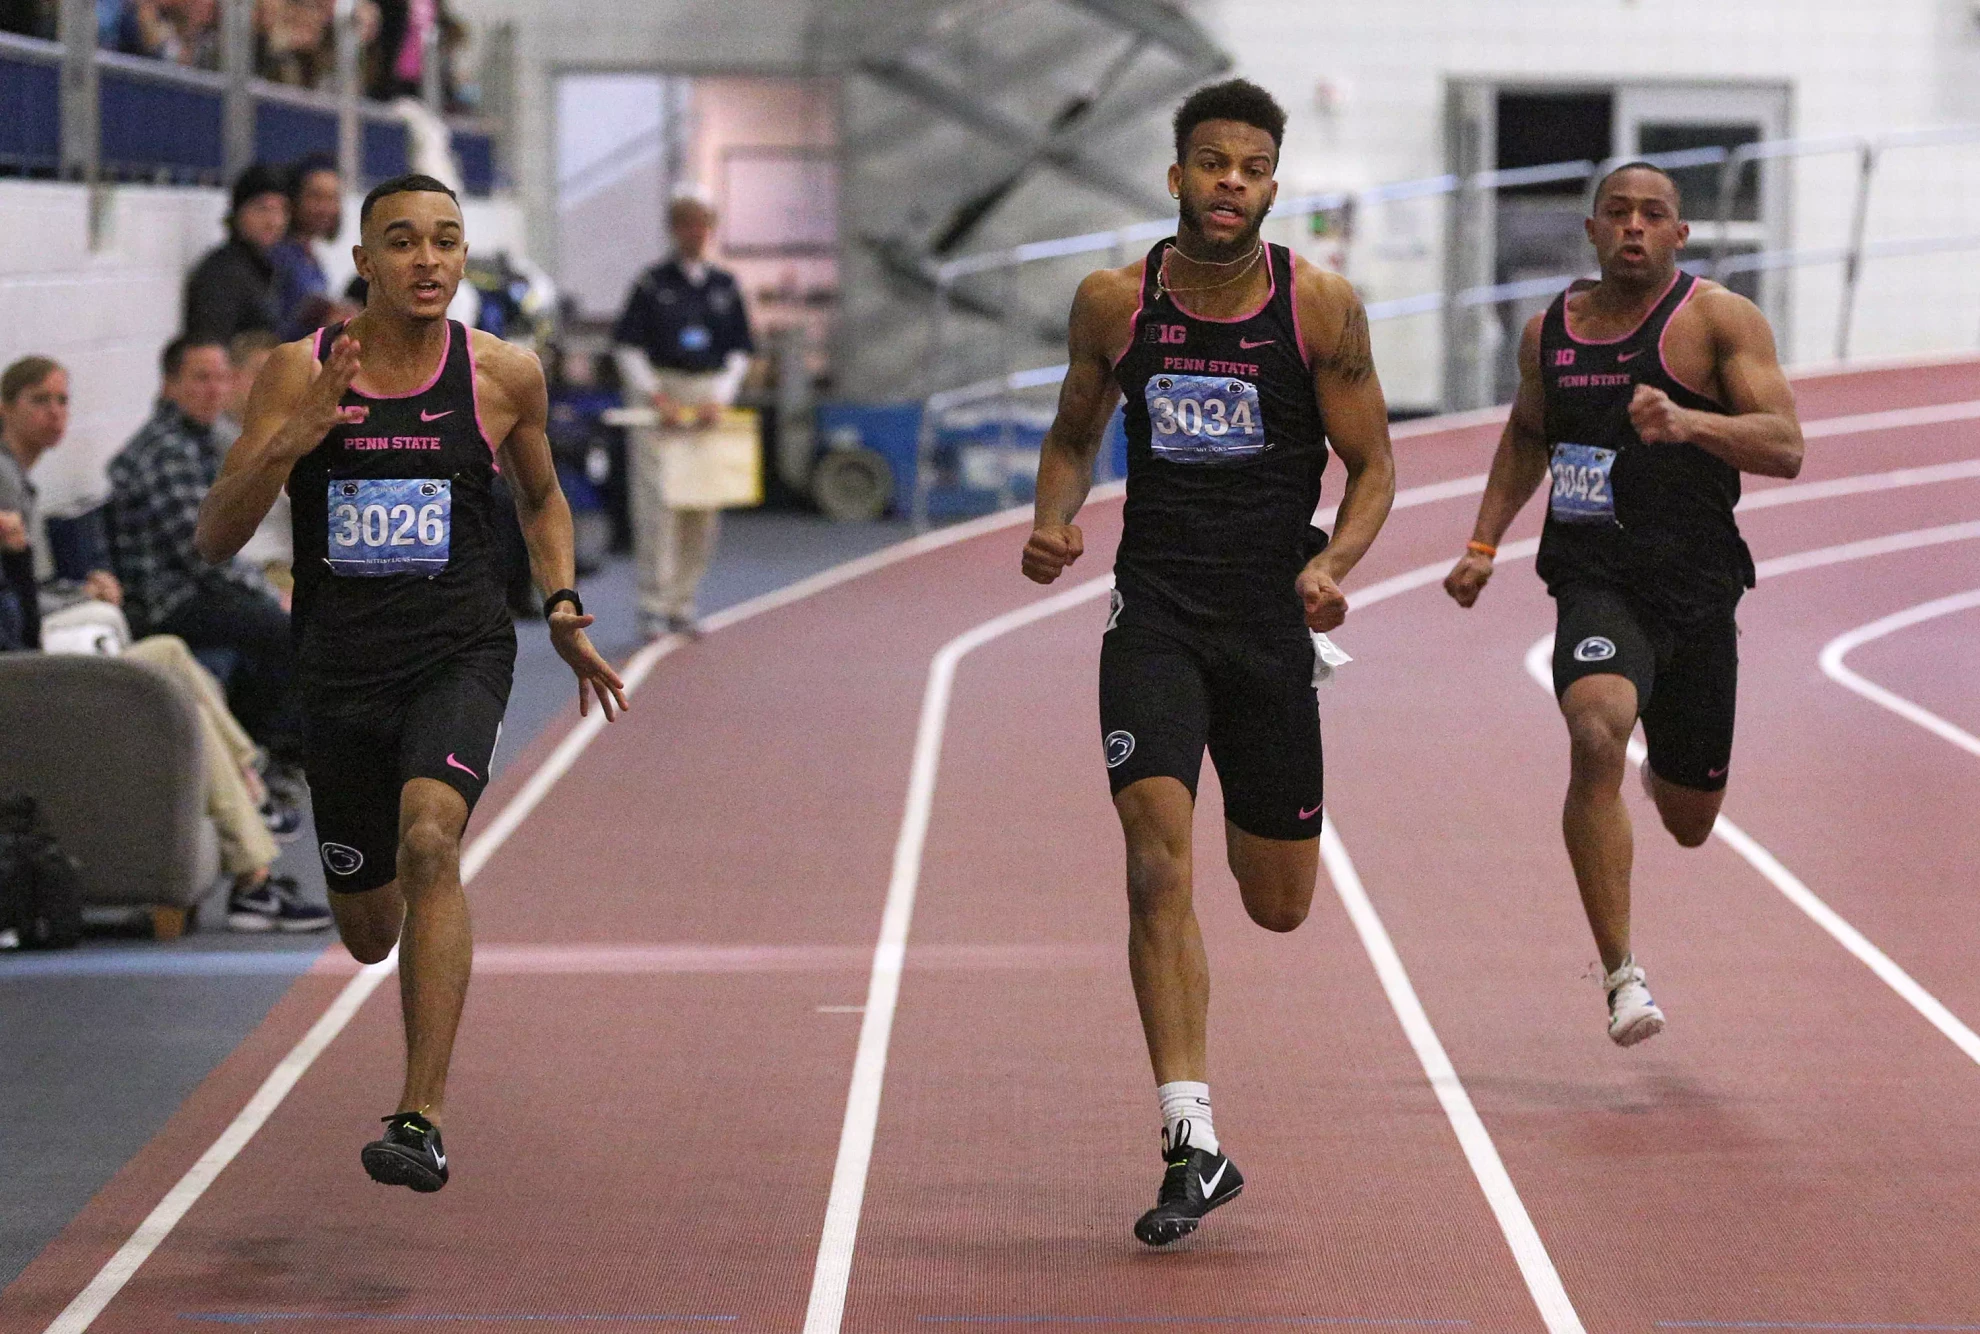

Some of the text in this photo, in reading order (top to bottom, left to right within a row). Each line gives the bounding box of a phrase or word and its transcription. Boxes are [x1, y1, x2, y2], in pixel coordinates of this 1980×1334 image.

[1163, 356, 1260, 376] PENN STATE
[1558, 373, 1631, 387] PENN STATE
[1153, 396, 1256, 436] 3034
[344, 436, 441, 450] PENN STATE
[1553, 463, 1608, 503] 3042
[335, 504, 444, 547] 3026
